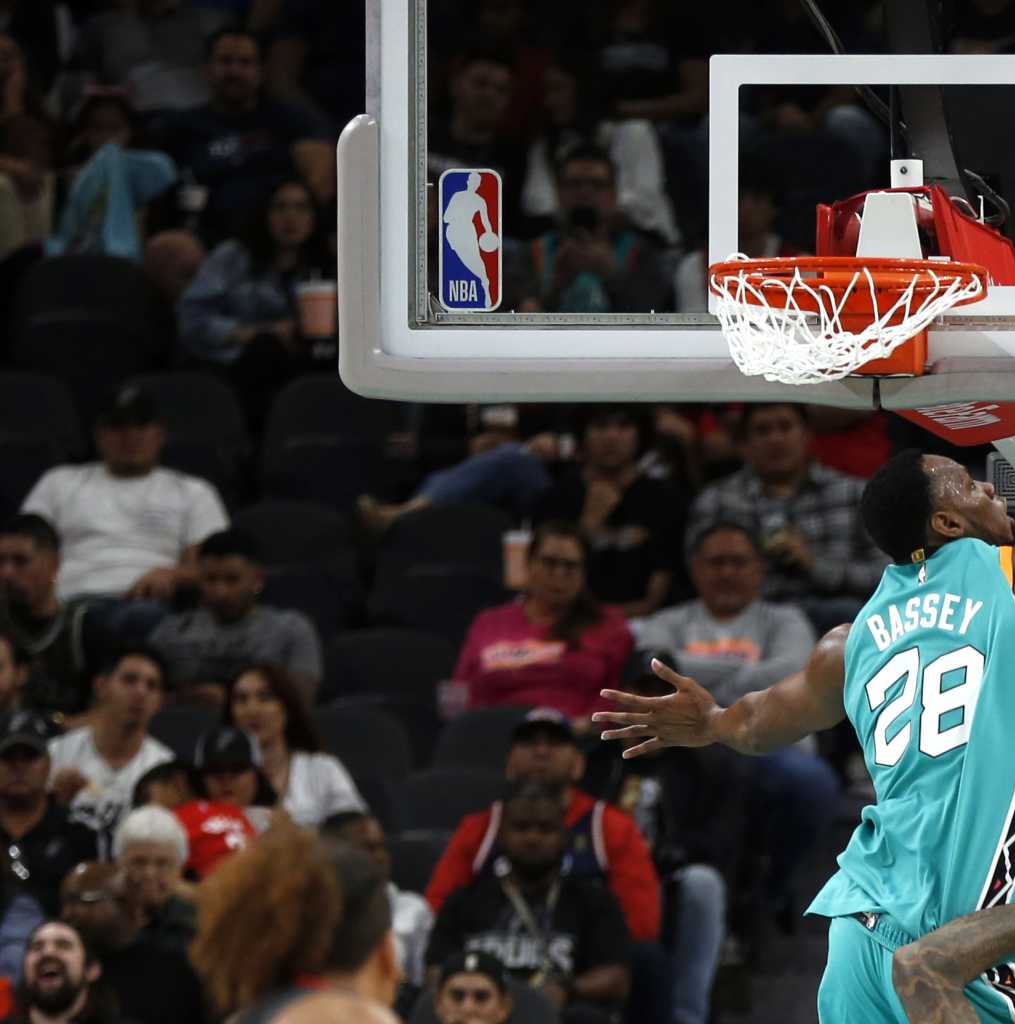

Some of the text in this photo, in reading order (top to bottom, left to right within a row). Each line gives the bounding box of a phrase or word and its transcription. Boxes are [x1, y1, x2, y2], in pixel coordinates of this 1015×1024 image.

[449, 280, 478, 302] NBA
[866, 592, 983, 653] BASSEY
[865, 644, 986, 767] 28
